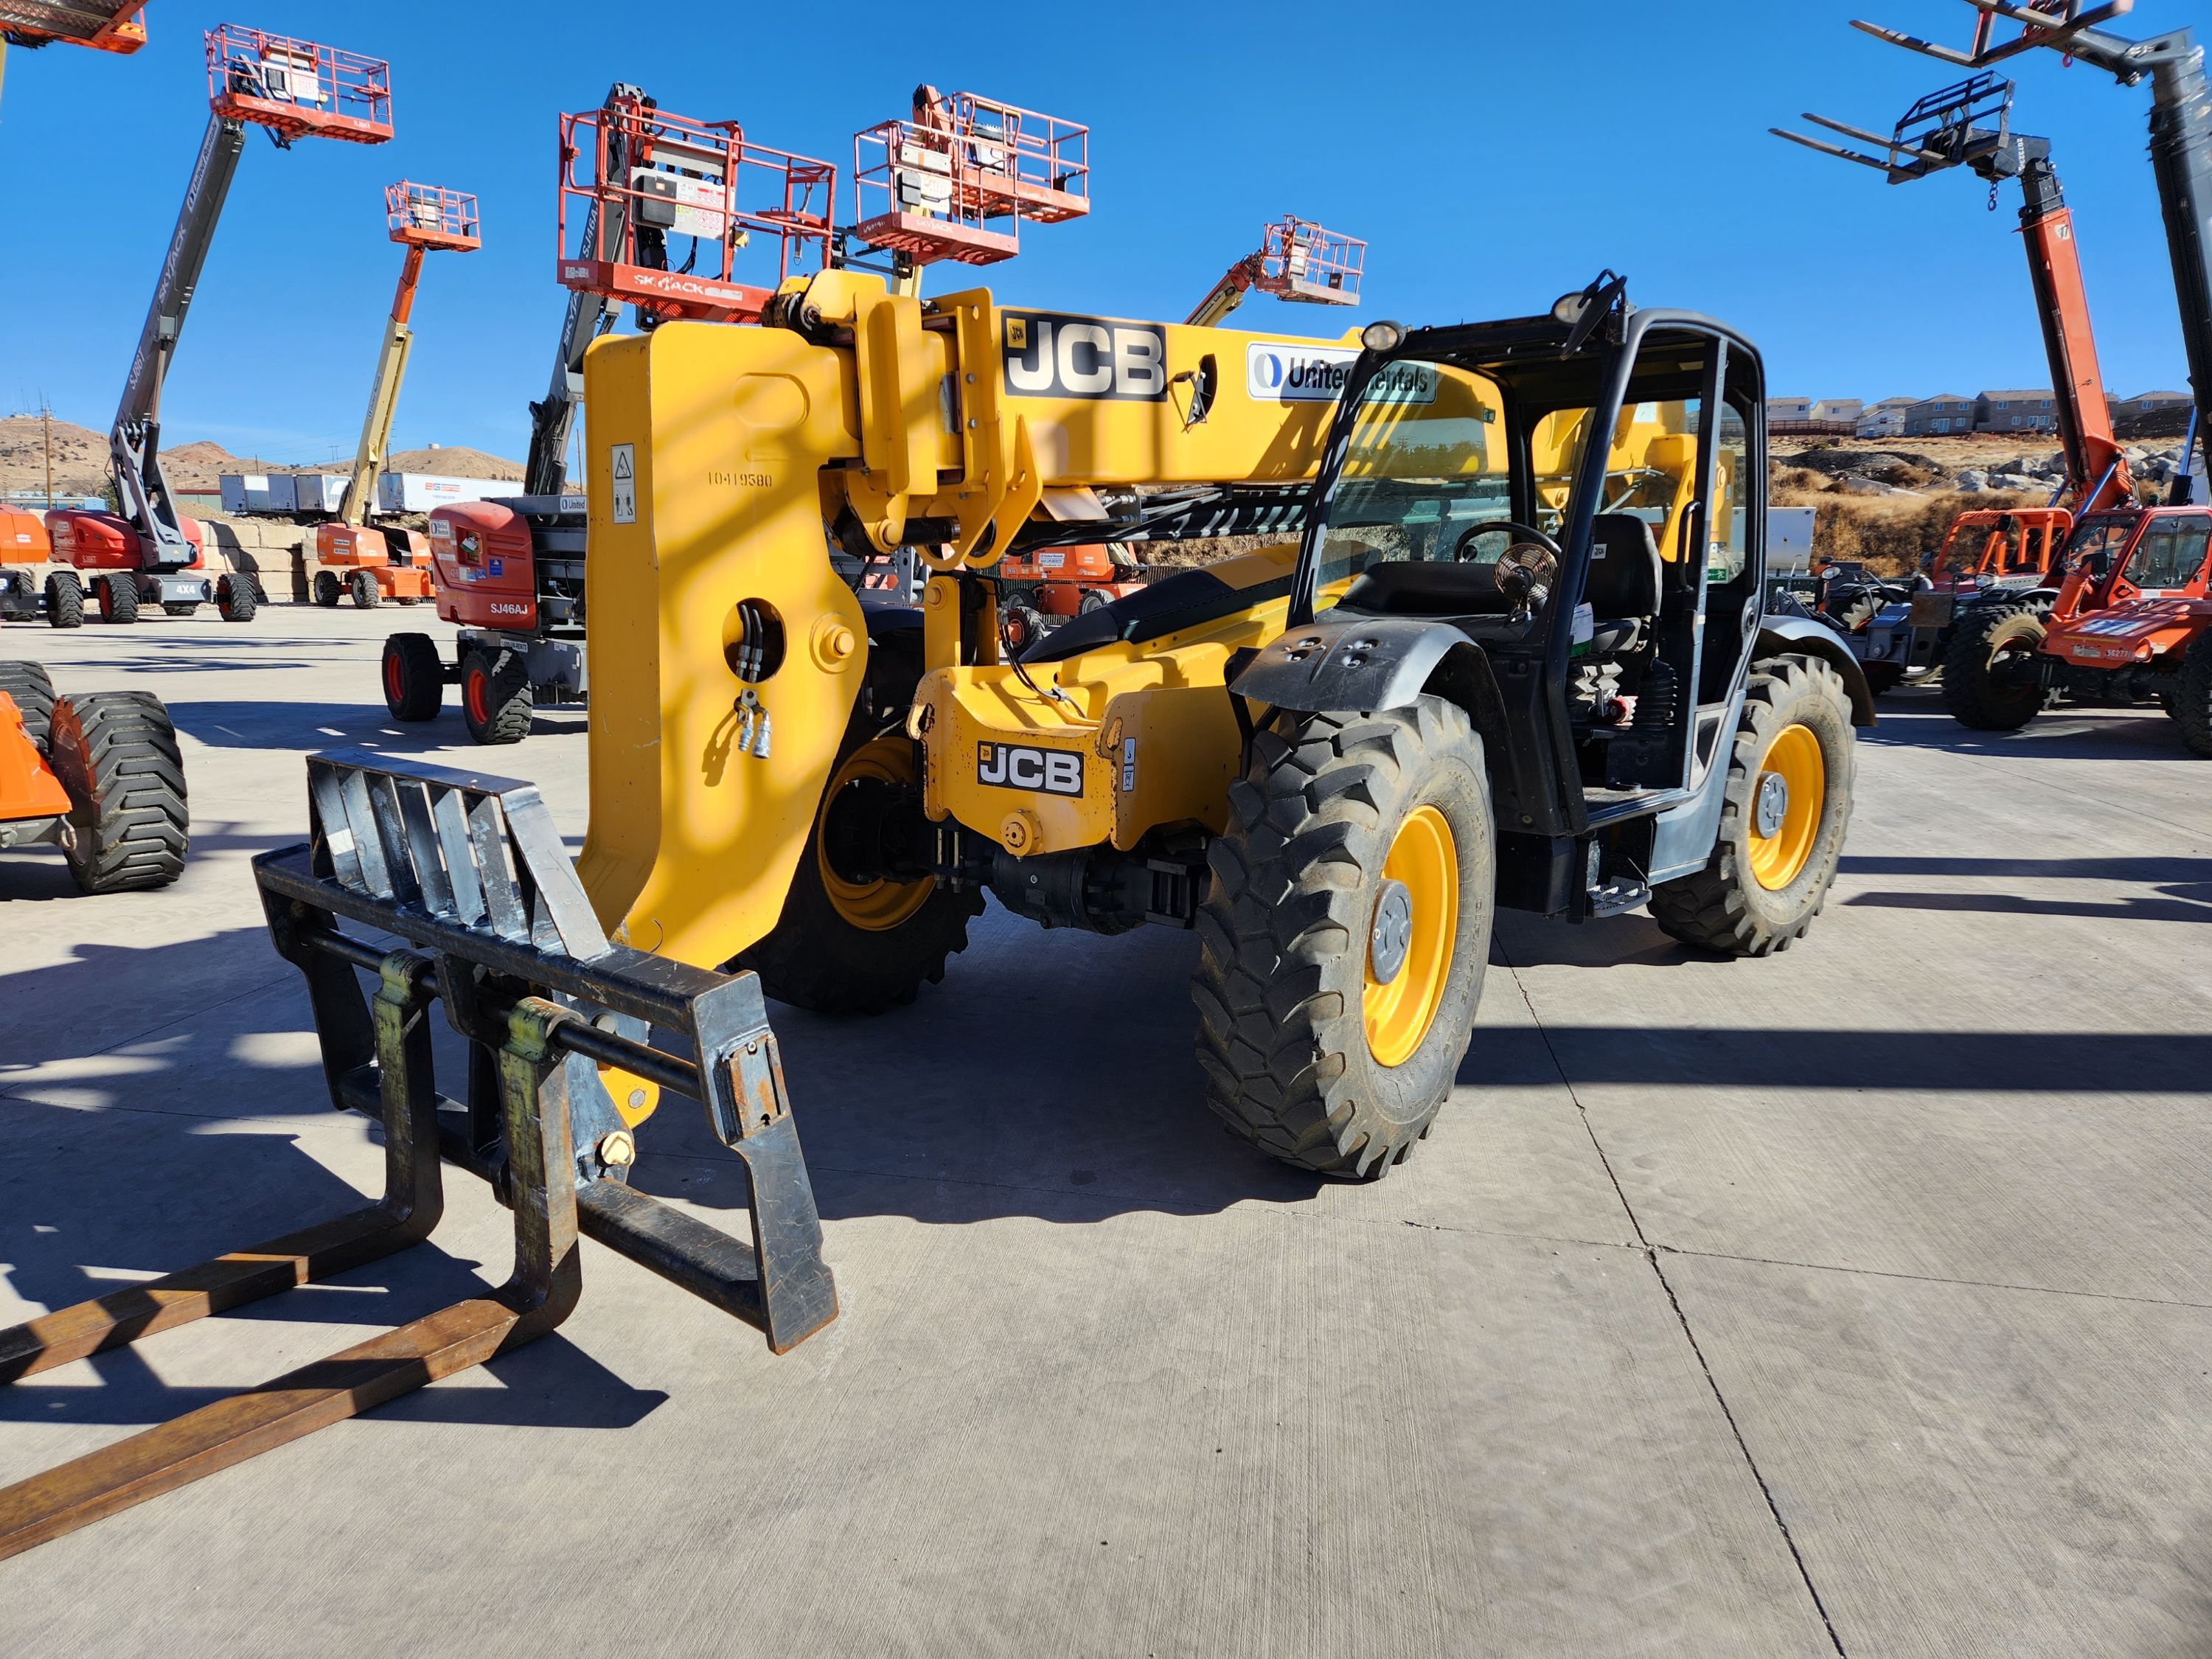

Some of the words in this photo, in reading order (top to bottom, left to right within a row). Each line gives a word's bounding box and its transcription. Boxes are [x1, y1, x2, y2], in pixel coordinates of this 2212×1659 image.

[192, 158, 206, 193] United
[204, 121, 218, 160] Rentals
[582, 197, 598, 258] SJ46A
[159, 223, 187, 304] SKYJACK
[1011, 326, 1024, 341] JCB
[129, 347, 145, 390] SJ86T
[1008, 321, 1165, 394] JCB
[1370, 365, 1428, 393] entals
[709, 471, 773, 487] 10419580
[568, 500, 585, 509] United
[176, 585, 195, 595] 4X4
[490, 603, 528, 615] SJ46AJ
[980, 746, 1082, 793] JCB
